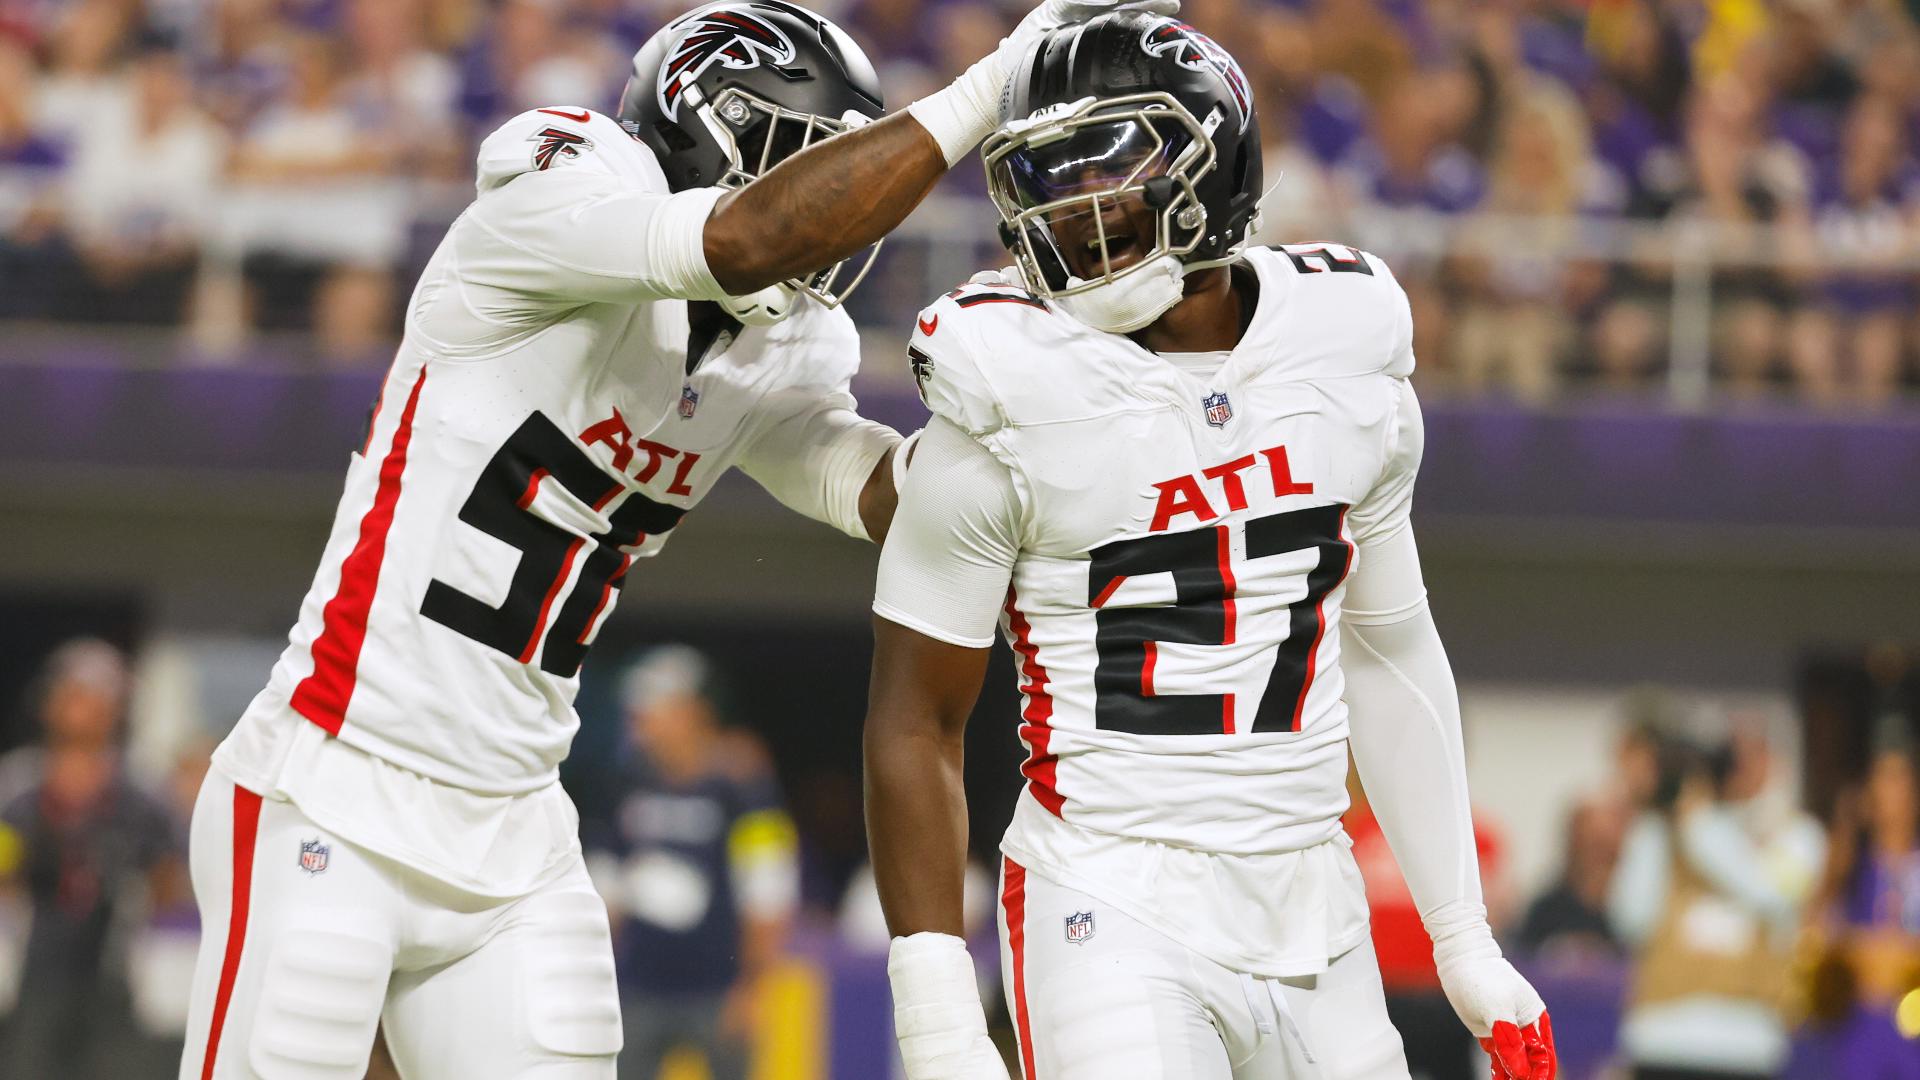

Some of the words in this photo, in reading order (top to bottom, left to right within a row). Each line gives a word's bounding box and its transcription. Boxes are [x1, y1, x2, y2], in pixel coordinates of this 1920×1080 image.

[1035, 105, 1059, 118] ATL
[1208, 404, 1230, 422] NFL
[578, 406, 701, 497] ATL
[1149, 444, 1314, 532] ATL
[1088, 503, 1354, 735] 27
[1069, 923, 1090, 937] NFL
